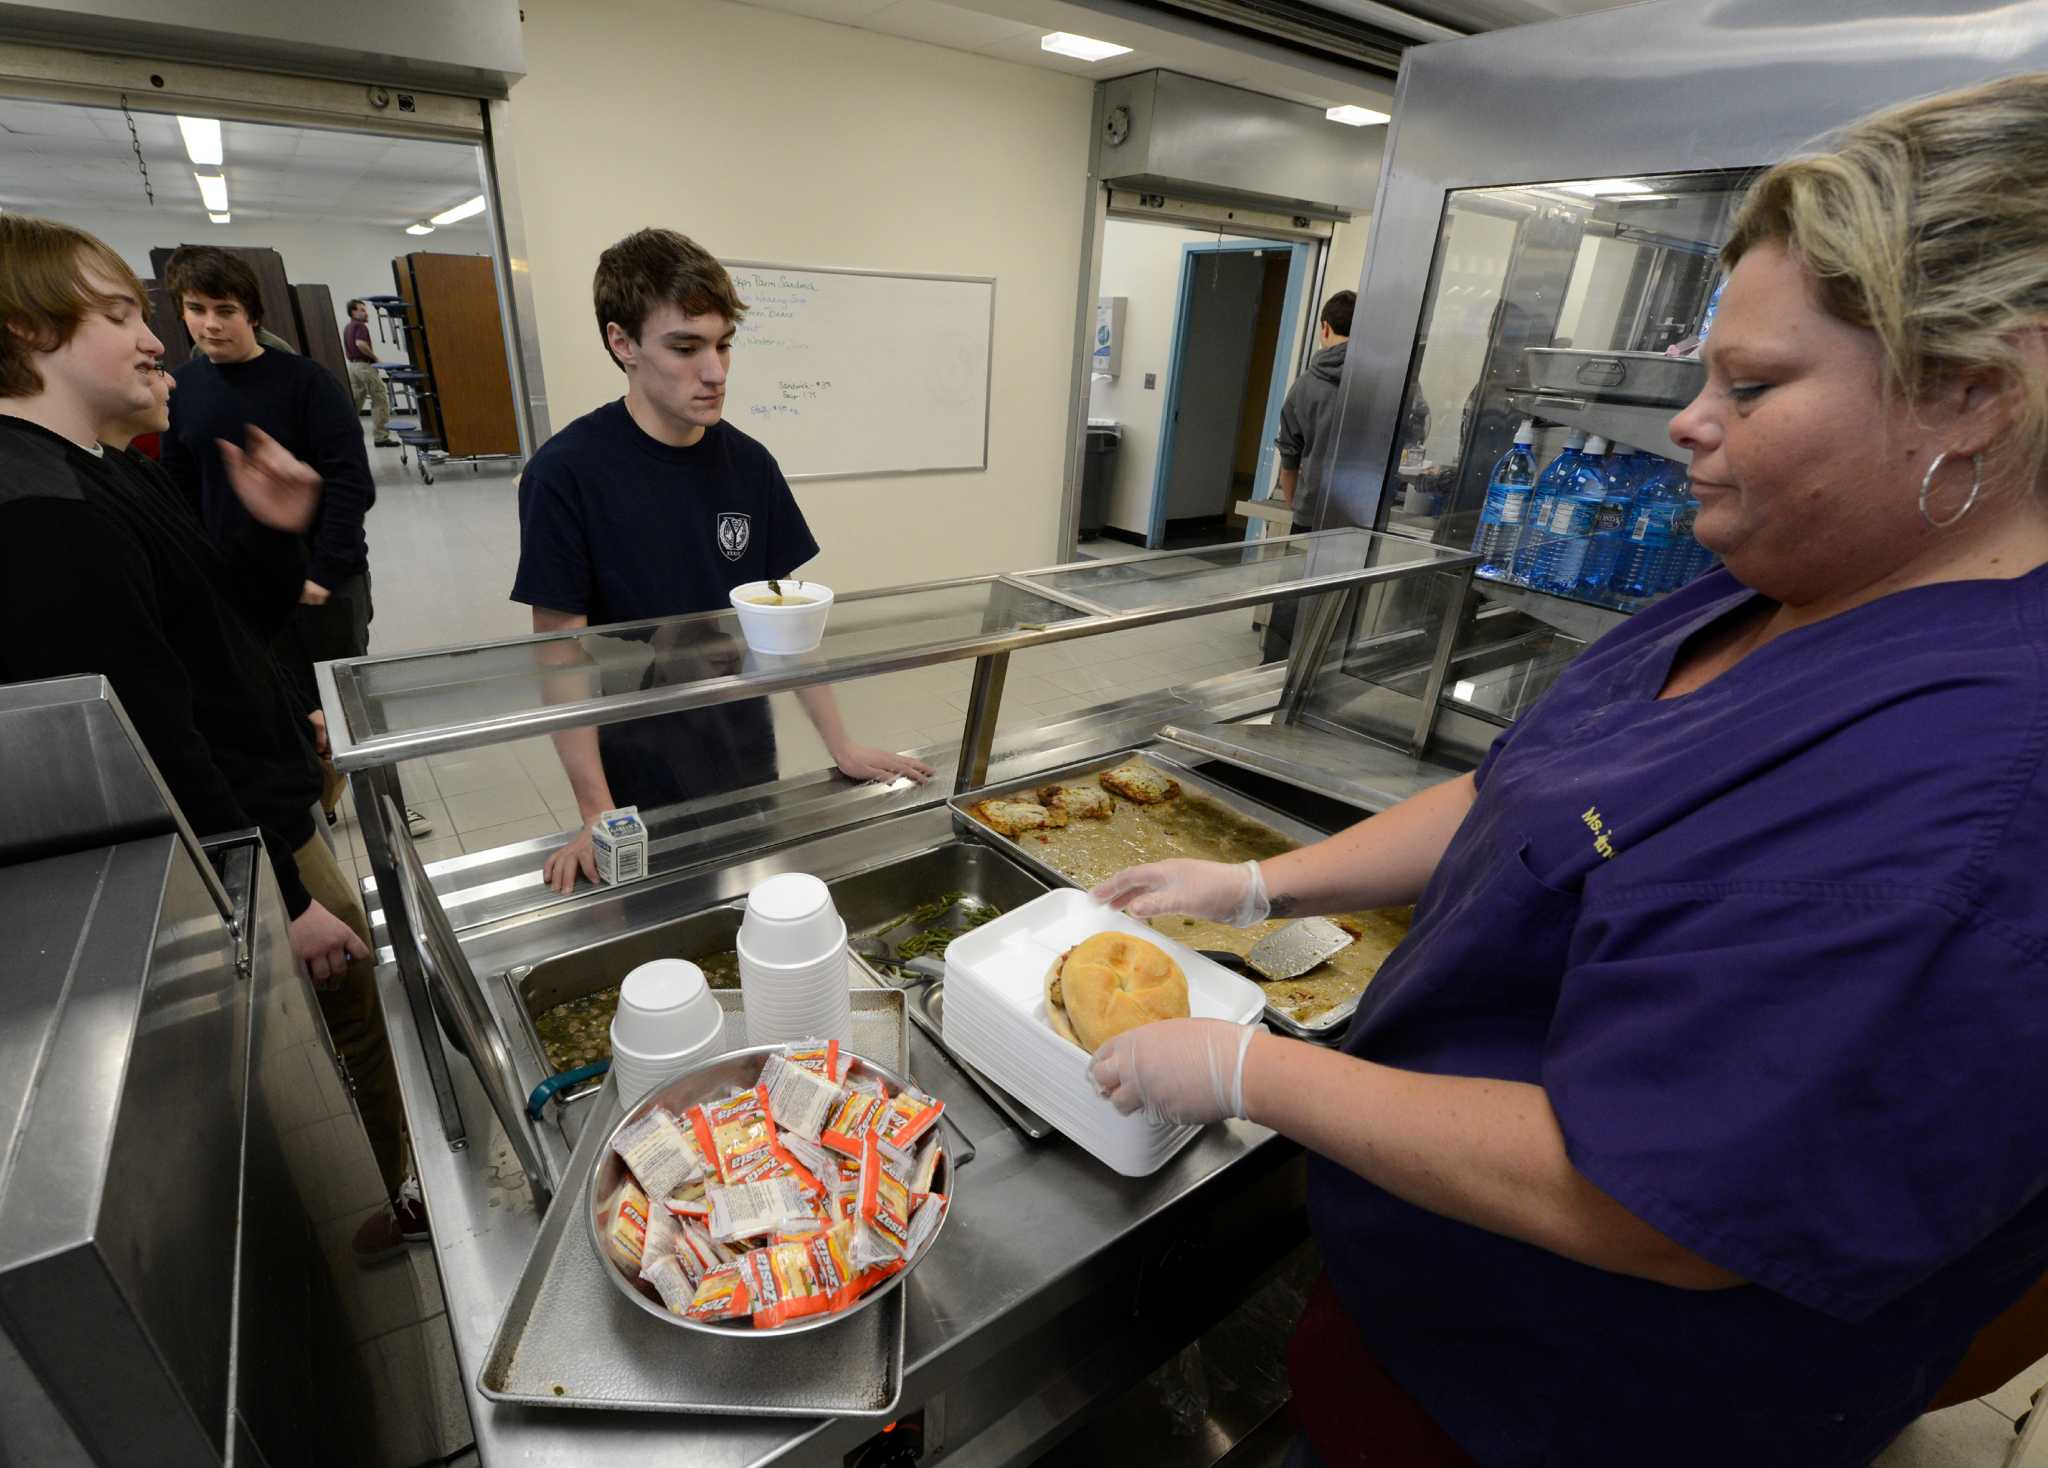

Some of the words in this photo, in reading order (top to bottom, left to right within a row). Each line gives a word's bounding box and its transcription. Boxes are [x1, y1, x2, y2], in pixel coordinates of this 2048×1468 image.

[1581, 806, 1603, 836] Ms.
[874, 1211, 908, 1241] Zesta
[756, 1252, 779, 1304] Zesta
[815, 1238, 840, 1290] Zesta
